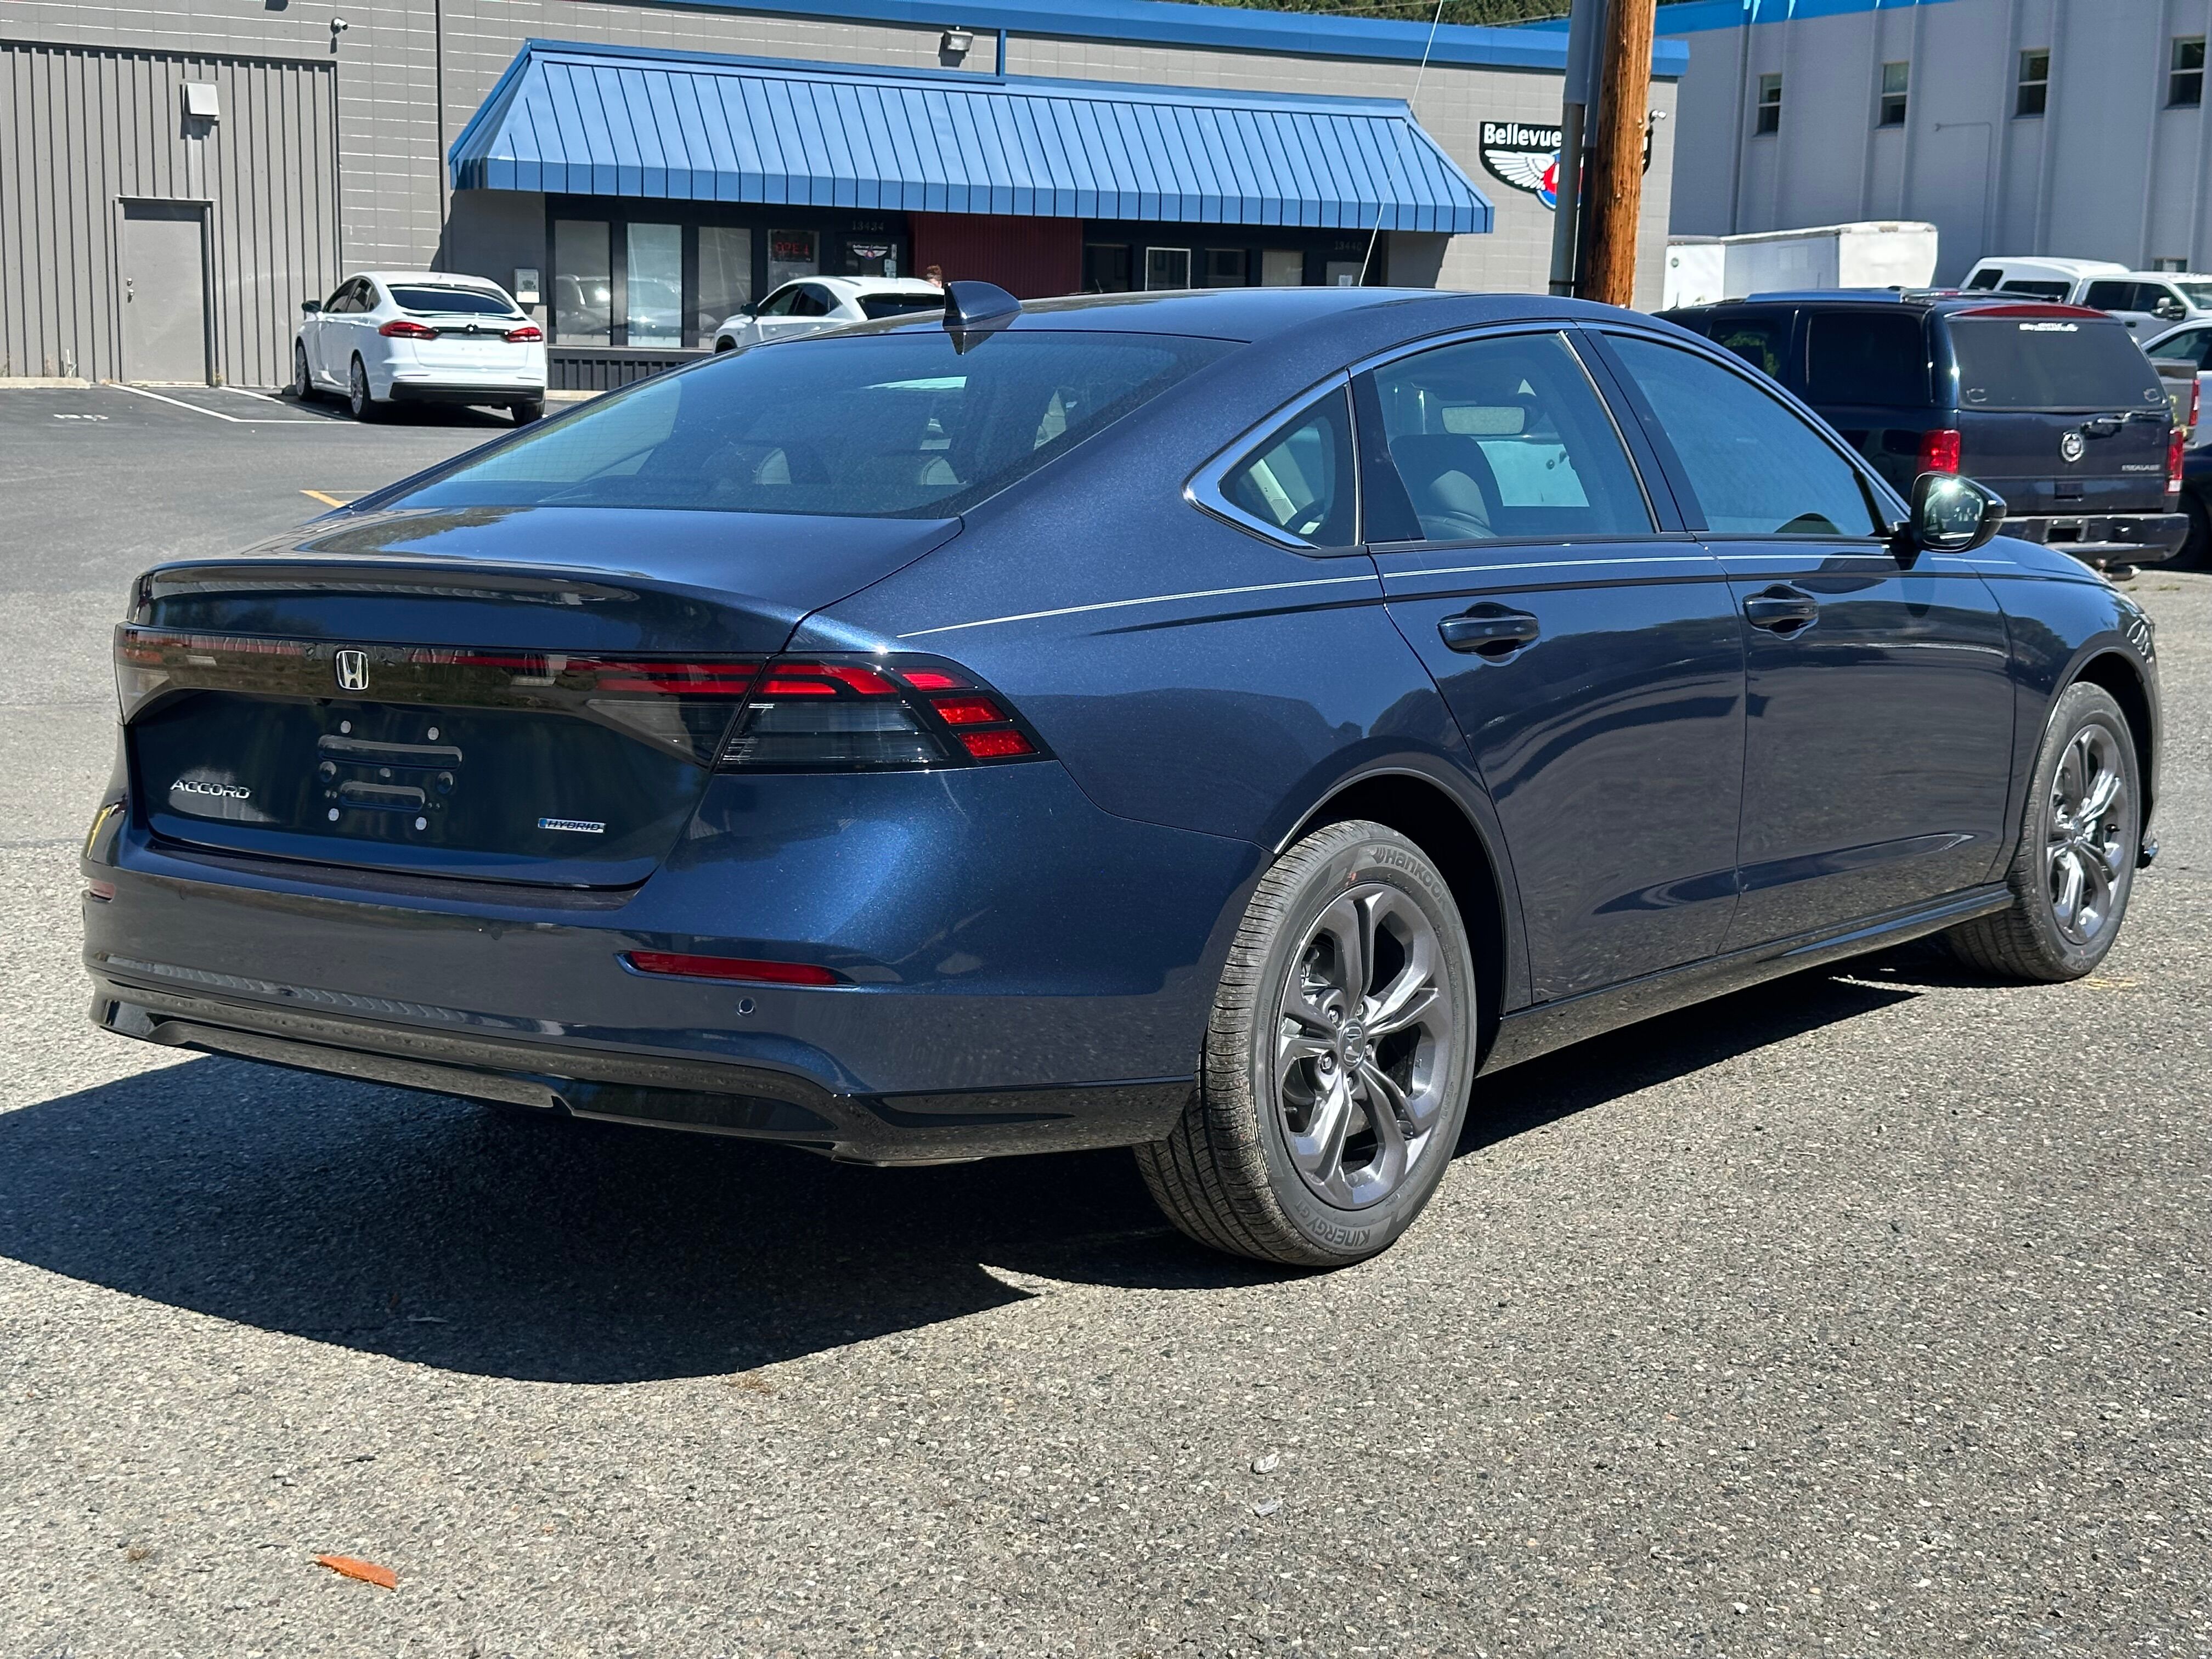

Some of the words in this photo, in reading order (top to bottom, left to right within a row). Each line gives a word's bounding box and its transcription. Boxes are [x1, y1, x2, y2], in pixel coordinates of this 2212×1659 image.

[1483, 123, 1562, 147] Bellevue
[170, 779, 250, 799] ACCORD
[549, 820, 601, 831] HYBRID
[1305, 1217, 1371, 1247] KINERGY
